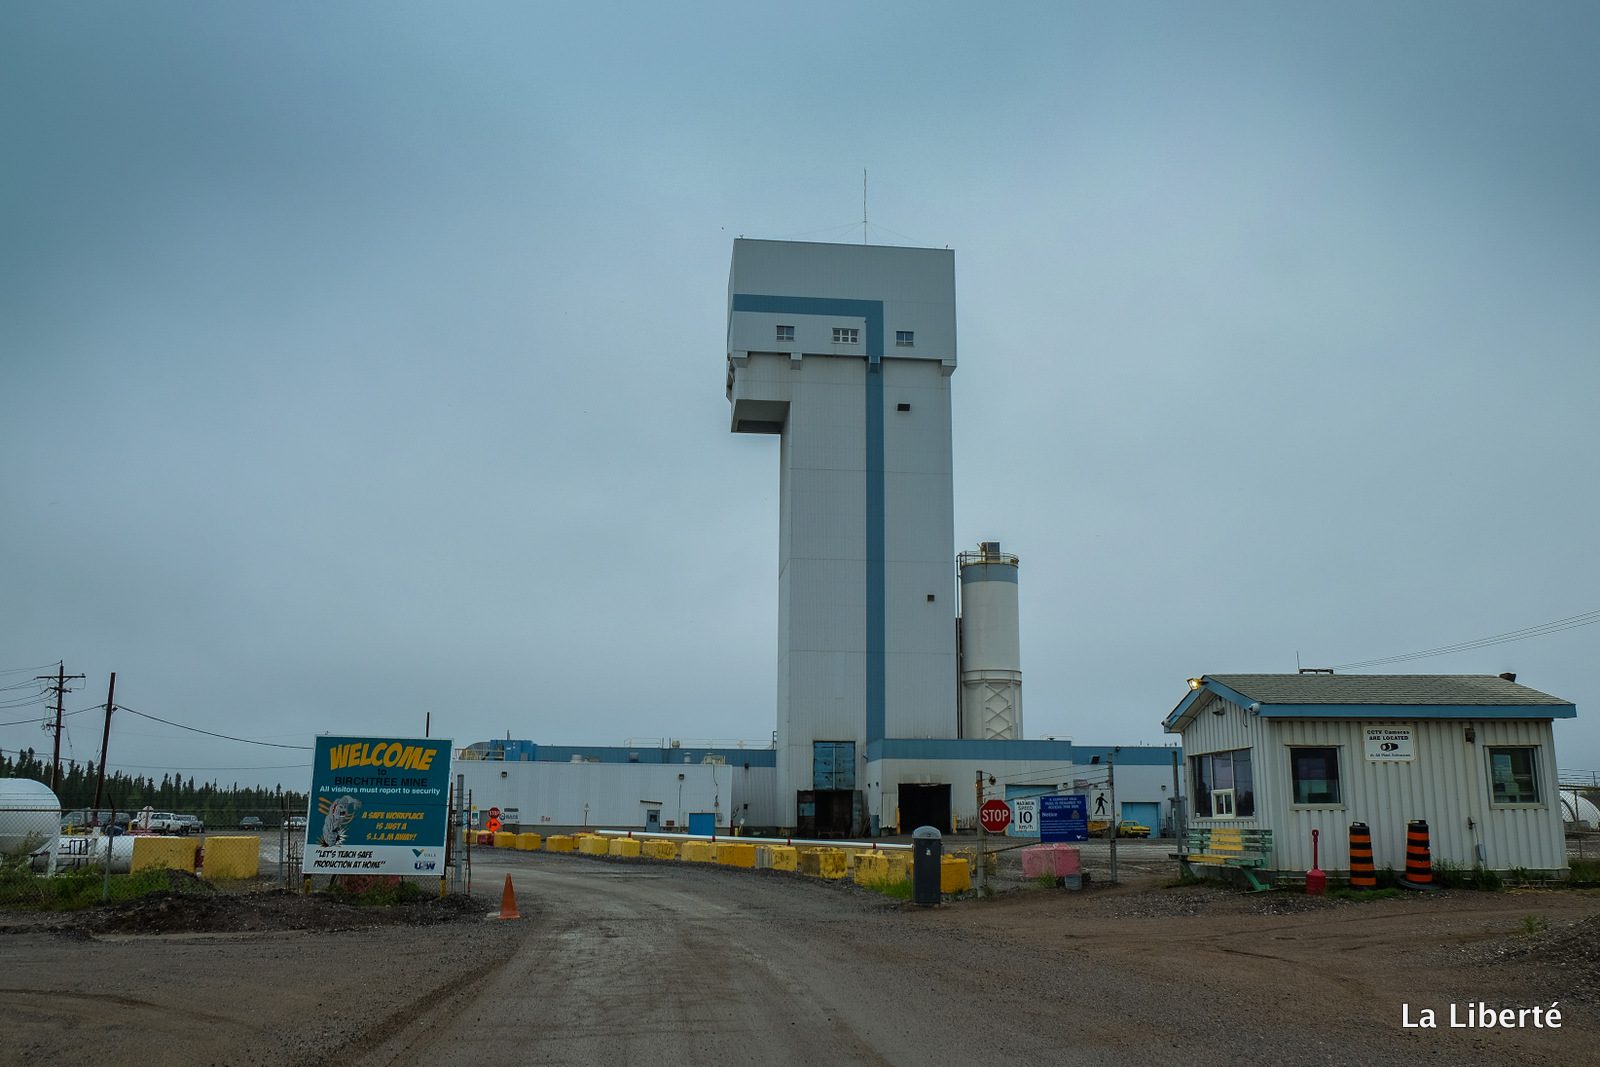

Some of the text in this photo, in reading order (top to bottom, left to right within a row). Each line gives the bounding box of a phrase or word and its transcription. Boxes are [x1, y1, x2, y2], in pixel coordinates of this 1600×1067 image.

[330, 742, 437, 770] WELCOME
[334, 776, 428, 786] BIRCHTREE MINE
[982, 810, 1008, 822] STOP
[1019, 812, 1033, 823] 10
[313, 860, 352, 868] PRODUCTION
